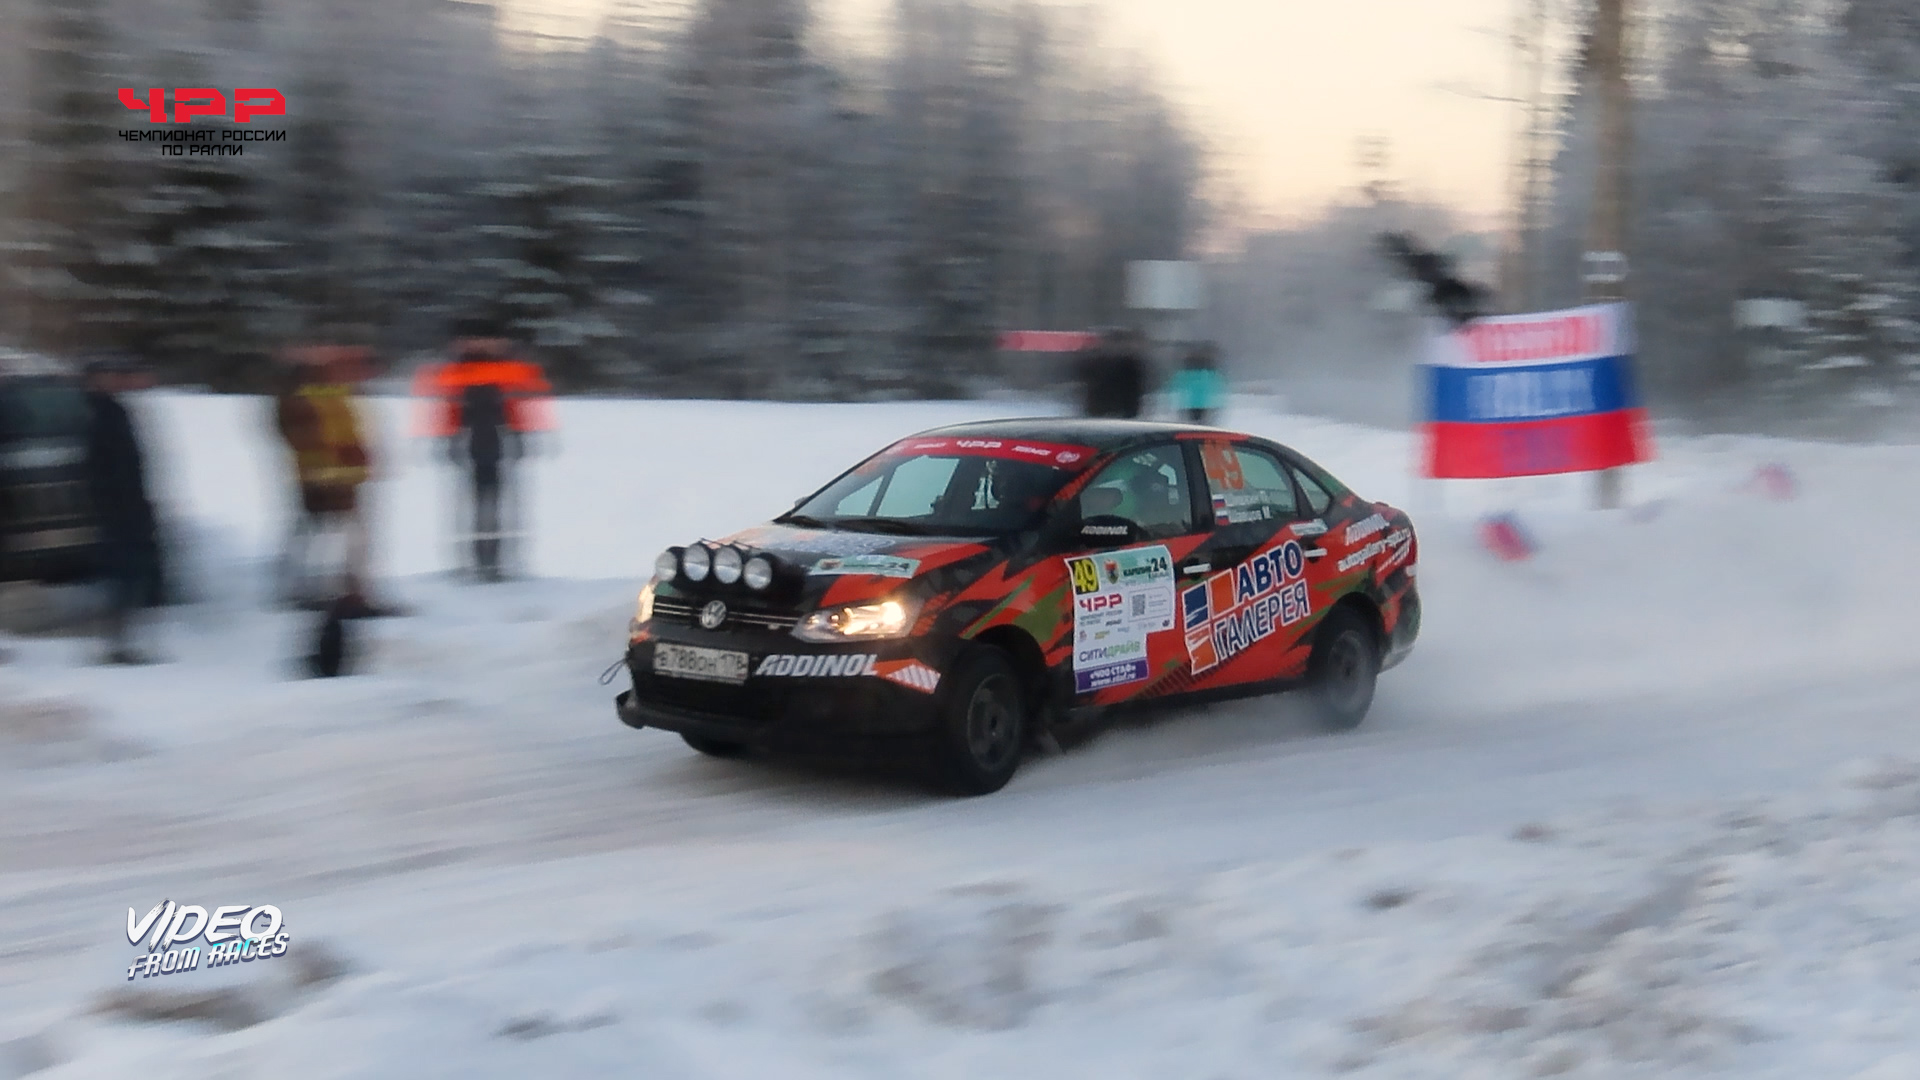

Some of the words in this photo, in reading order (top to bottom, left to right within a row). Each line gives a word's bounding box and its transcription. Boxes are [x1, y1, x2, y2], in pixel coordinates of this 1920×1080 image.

[1203, 439, 1244, 490] 49
[1074, 559, 1098, 593] 49
[1237, 540, 1302, 603] АВТО
[1080, 593, 1122, 612] ЧРР
[1214, 580, 1311, 660] ГАЛЕРЕЯ
[756, 653, 878, 677] ADDINOL
